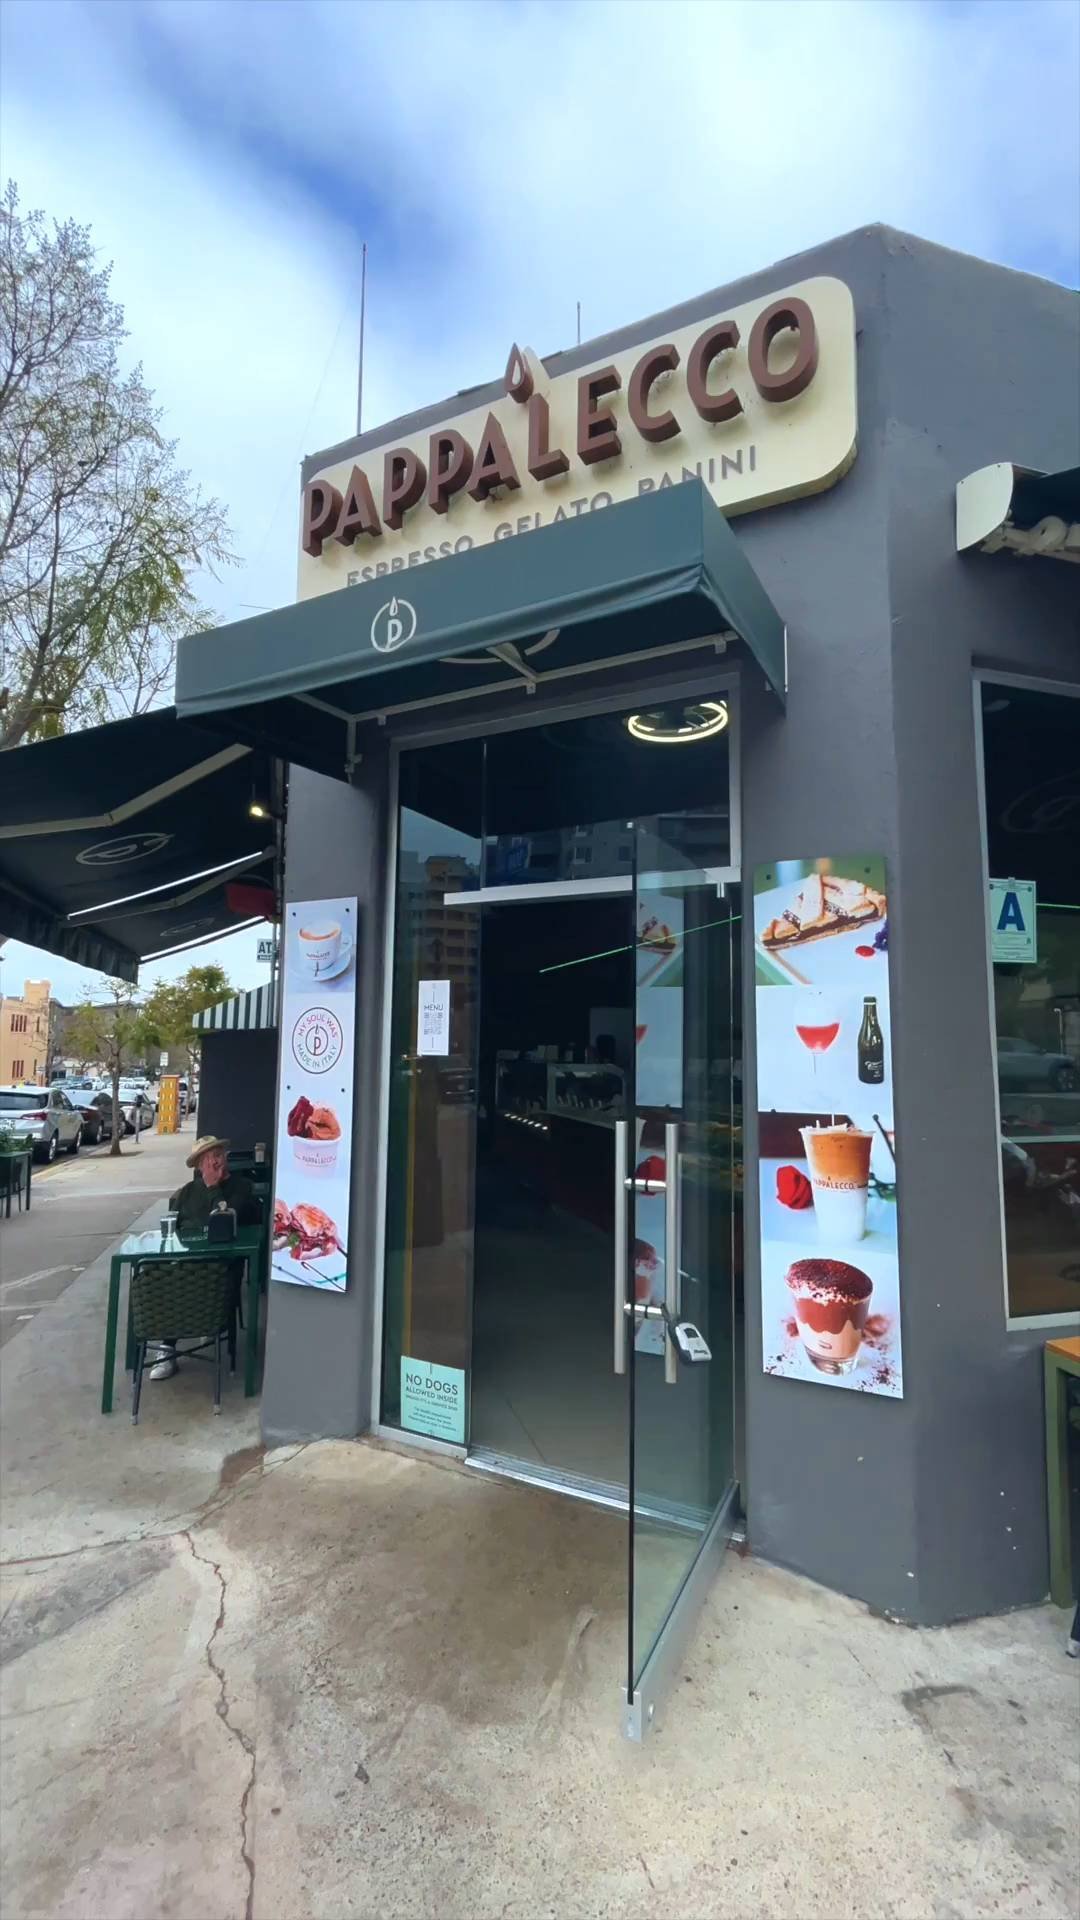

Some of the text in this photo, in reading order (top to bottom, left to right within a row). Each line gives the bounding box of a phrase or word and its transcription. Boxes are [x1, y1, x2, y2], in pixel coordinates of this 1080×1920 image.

[301, 296, 819, 557] PAPPALECCO
[347, 535, 474, 587] ESPRESSO
[638, 445, 756, 496] PANINI
[997, 891, 1026, 931] A
[424, 1003, 444, 1011] MENU
[406, 1373, 458, 1395] NO DOGS
[406, 1386, 436, 1398] ALLOWED
